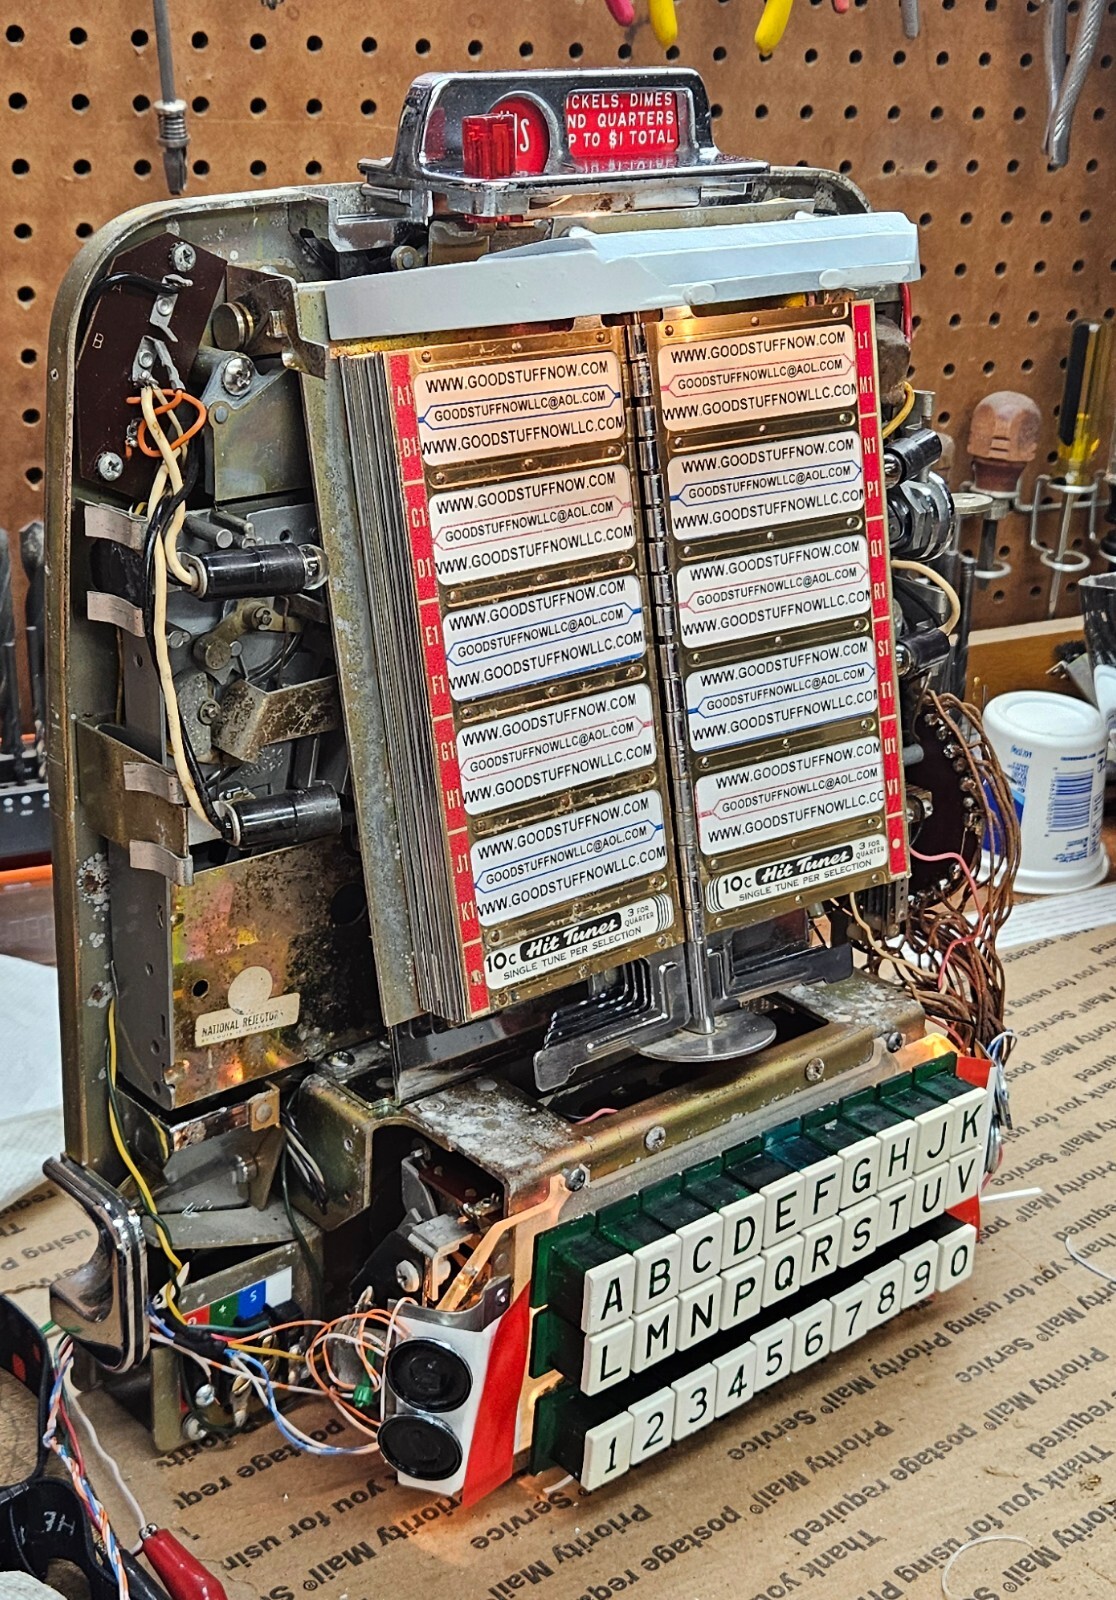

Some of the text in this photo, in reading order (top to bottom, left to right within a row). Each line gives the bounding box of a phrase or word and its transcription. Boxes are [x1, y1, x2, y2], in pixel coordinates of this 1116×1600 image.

[629, 91, 673, 108] DIMES
[597, 110, 674, 128] QUARTERS
[583, 131, 600, 148] TO
[629, 129, 675, 145] TOTAL
[671, 331, 847, 364] WWW.GOODSTUFFNOW.COM
[856, 331, 870, 350] L1
[425, 360, 609, 394] WWW.GOODSTUFFNOW.COM
[677, 359, 843, 390] GOODSTUFFNOWLLC@AOL.COM
[859, 375, 874, 395] M1
[396, 385, 411, 407] A1
[434, 390, 606, 422] GOODSTUFFNOWLLC@AOL.COM
[401, 436, 418, 458] B1
[681, 438, 854, 474] WWW.GOODSTUFFNOW.COM
[863, 437, 877, 455] N1
[436, 472, 616, 514] WWW.GOODSTUFFNOW.COM
[688, 465, 851, 499] GOODSTUFFNOWLLC@AOL.COM
[867, 479, 879, 498] P1
[411, 506, 427, 528] C1
[445, 501, 614, 543] GOODSTUFFNOWLLC@AOL.COM
[690, 540, 860, 582] WWW.GOODSTUFFNOW.COM
[870, 539, 883, 558] Q1
[416, 556, 433, 579] D1
[696, 567, 857, 606] GOODSTUFFNOWLLC@AOL.COM
[874, 582, 886, 600] R1
[448, 579, 626, 632] WWW.GOODSTUFFNOW.COM
[425, 626, 440, 646] E1
[457, 608, 624, 659] GOODSTUFFNOWLLC@AOL.COM
[877, 639, 890, 658] S1
[700, 641, 868, 687] WWW.GOODSTUFFNOW.COM
[431, 675, 446, 696] F1
[706, 667, 865, 712] GOODSTUFFNOWLLC@AOL.COM
[880, 681, 892, 700] T1
[462, 693, 637, 748] WWW.GOODSTUFFNOW.COM
[441, 741, 456, 762] G1
[469, 722, 635, 773] GOODSTUFFNOWLLC@AOL.COM
[884, 737, 897, 756] U1
[716, 741, 881, 790] WWW.GOODSTUFFNOW.COM
[446, 788, 462, 811] H1
[721, 767, 878, 814] GOODSTUFFNOWLLC@AOL.COM
[886, 778, 899, 797] V1
[478, 797, 650, 861] WWW.GOODSTUFFNOW.COM
[858, 839, 881, 850] 3 FOR
[455, 854, 470, 875] J1
[485, 825, 647, 886] GOODSTUFFNOWLLC@AOL.COM
[761, 863, 794, 884] Hit
[795, 850, 851, 874] Tunes
[855, 845, 885, 860] QUARTER
[739, 859, 872, 902] SINGLE TUNE PER SELECTION
[461, 900, 476, 923] K1
[624, 912, 655, 928] QUARTER
[626, 905, 650, 918] 3 FOR
[503, 926, 643, 981] SINGLE TUNE PER SELECTION
[526, 938, 561, 959] Hit
[562, 918, 620, 945] Tunes
[1003, 938, 1057, 963] postage
[1007, 965, 1102, 1008] you for using
[1018, 1009, 1077, 1037] Service
[1030, 1096, 1087, 1128] you for
[990, 1152, 1058, 1186] Service
[600, 1102, 983, 1321] A B C D E F G H J K
[21, 1229, 92, 1259] using
[600, 1158, 976, 1382] L M N P Q R S T U V
[1030, 1260, 1069, 1286] you
[1003, 1284, 1036, 1305] for
[944, 1298, 1003, 1335] using
[604, 1244, 968, 1474] 1 2 3 4 5 6 7 8 9 0
[870, 1331, 953, 1379] Priority
[955, 1337, 1035, 1384] Service
[1029, 1346, 1110, 1395] Priority
[727, 1409, 817, 1461] Service
[1026, 1399, 1115, 1460] required
[805, 1420, 895, 1474] Priority
[889, 1422, 978, 1481] postage
[287, 1478, 388, 1539] you for
[470, 1491, 573, 1550] Service
[789, 1479, 891, 1547] required
[893, 1445, 1115, 1583] Thank you for using
[551, 1503, 654, 1565] Priority
[641, 1505, 742, 1572] postage
[798, 1529, 885, 1578] Thank
